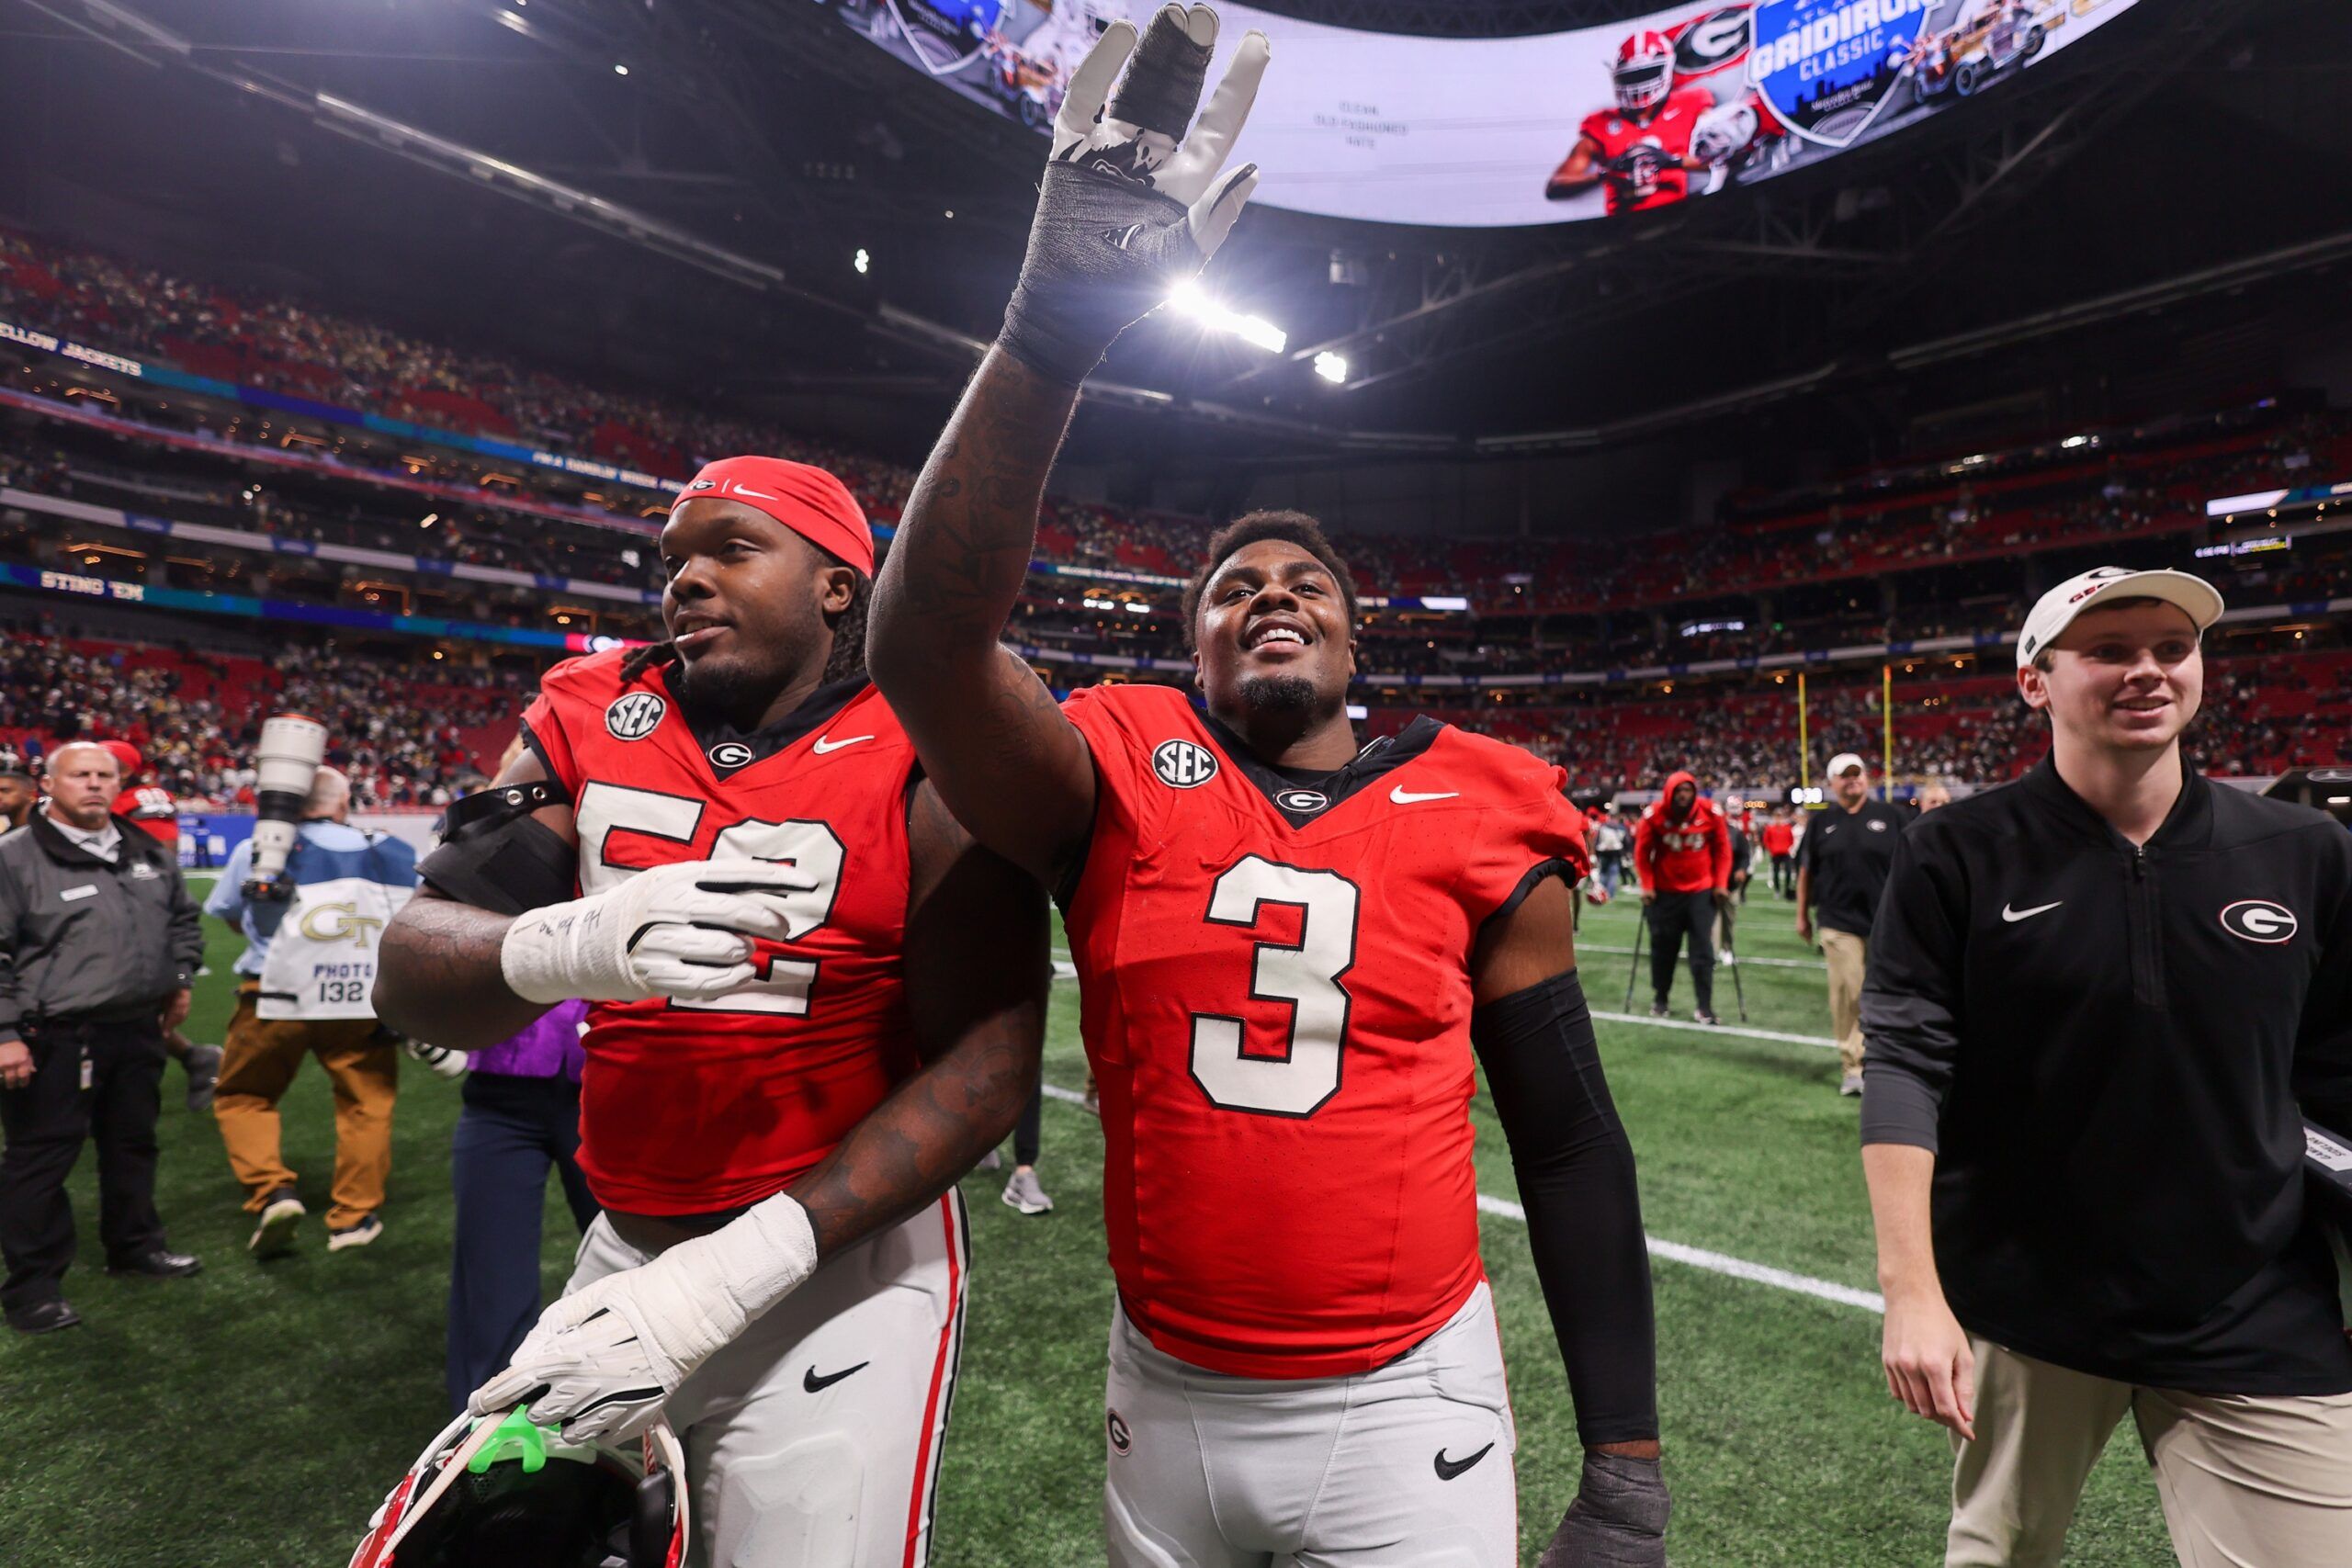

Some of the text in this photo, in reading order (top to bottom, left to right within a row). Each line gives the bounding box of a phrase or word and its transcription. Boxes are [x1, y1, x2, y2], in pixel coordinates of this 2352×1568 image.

[1799, 28, 1883, 82] CLASSIC
[61, 342, 142, 377] JACKETS
[40, 570, 144, 602] STING 'EM
[610, 700, 663, 737] SEC
[1157, 746, 1214, 787] SEC
[300, 902, 382, 949] GT
[321, 982, 364, 1003] 132
[1188, 852, 1361, 1120] 3
